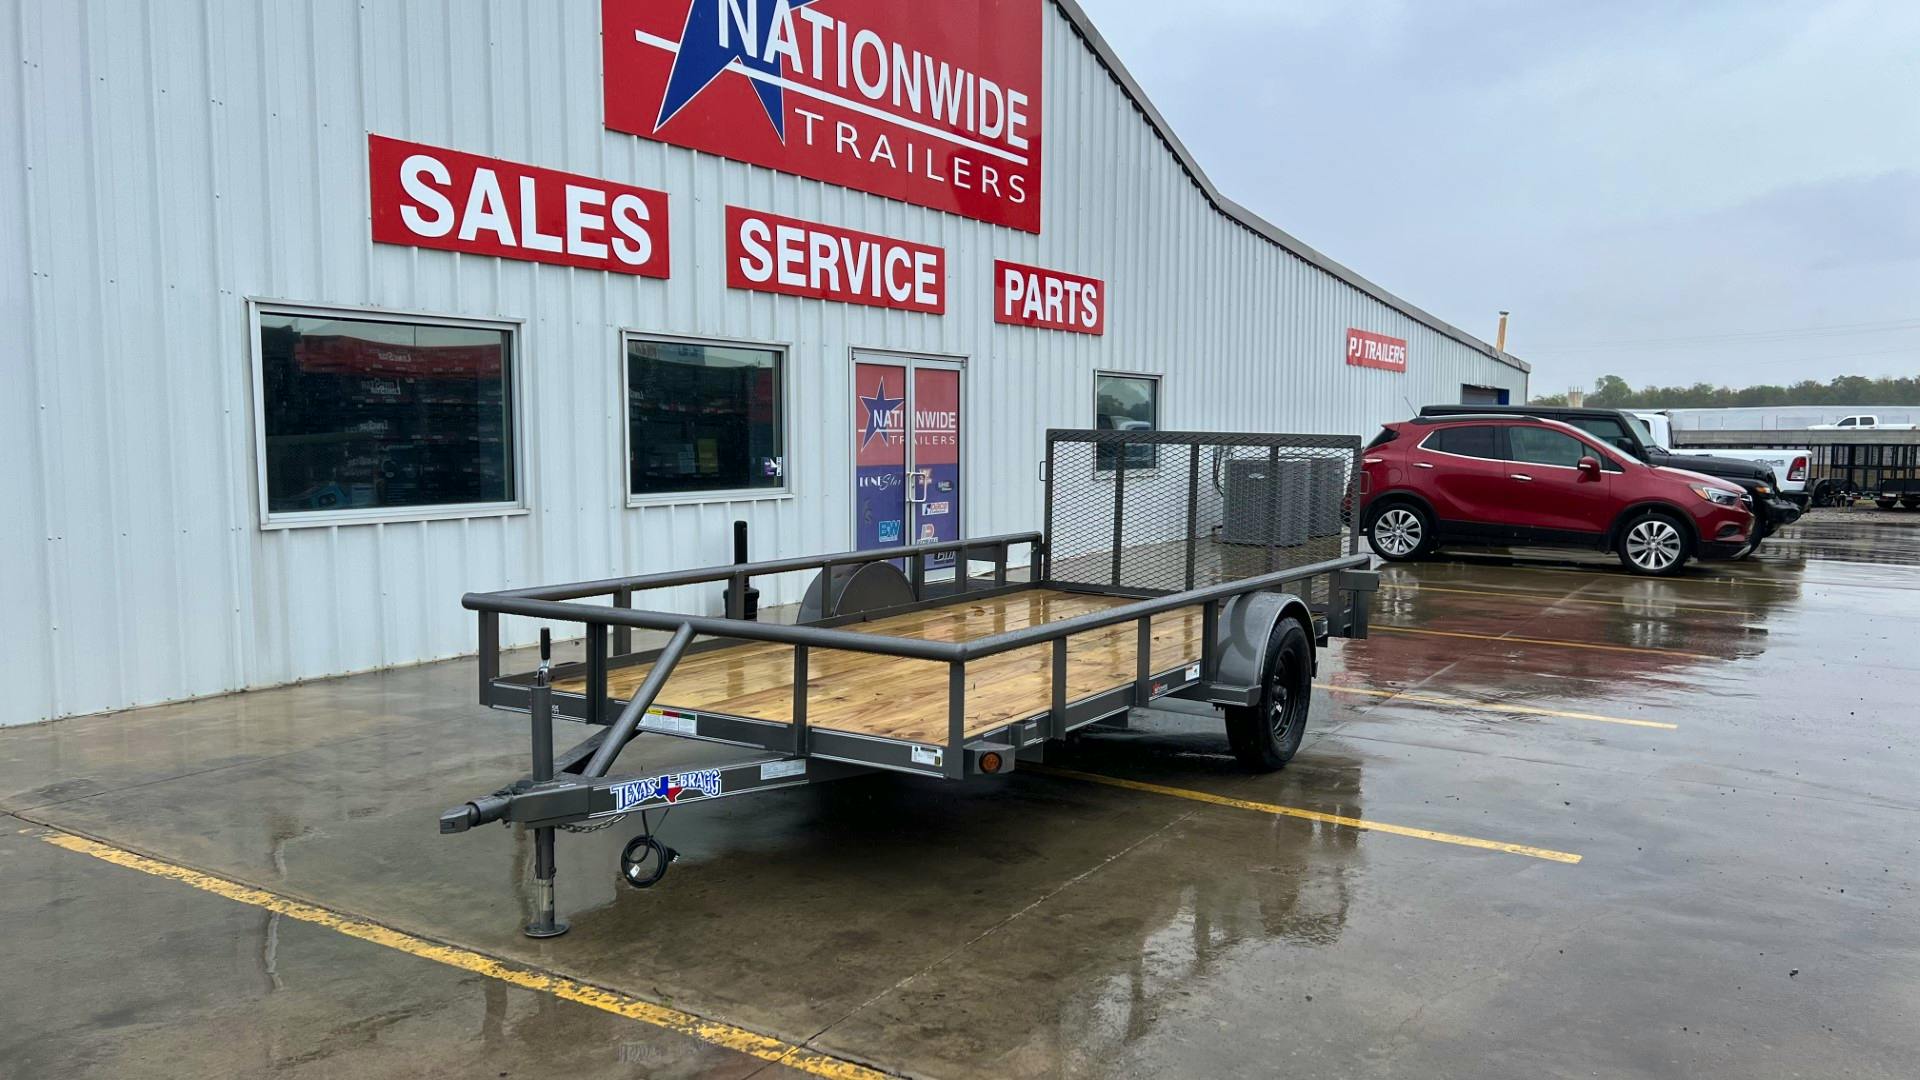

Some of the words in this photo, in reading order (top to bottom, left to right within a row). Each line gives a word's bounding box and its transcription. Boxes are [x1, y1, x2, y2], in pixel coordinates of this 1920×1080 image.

[718, 0, 1028, 150] NATIONWIDE
[794, 107, 1026, 204] TRAILERS
[400, 154, 652, 265] SALES
[739, 218, 938, 305] SERVICE
[1004, 269, 1098, 328] PARTS
[1349, 336, 1363, 357] PJ
[1364, 339, 1406, 365] TRAILERS
[609, 778, 656, 813] TEXAS
[679, 768, 722, 797] BRAGG
